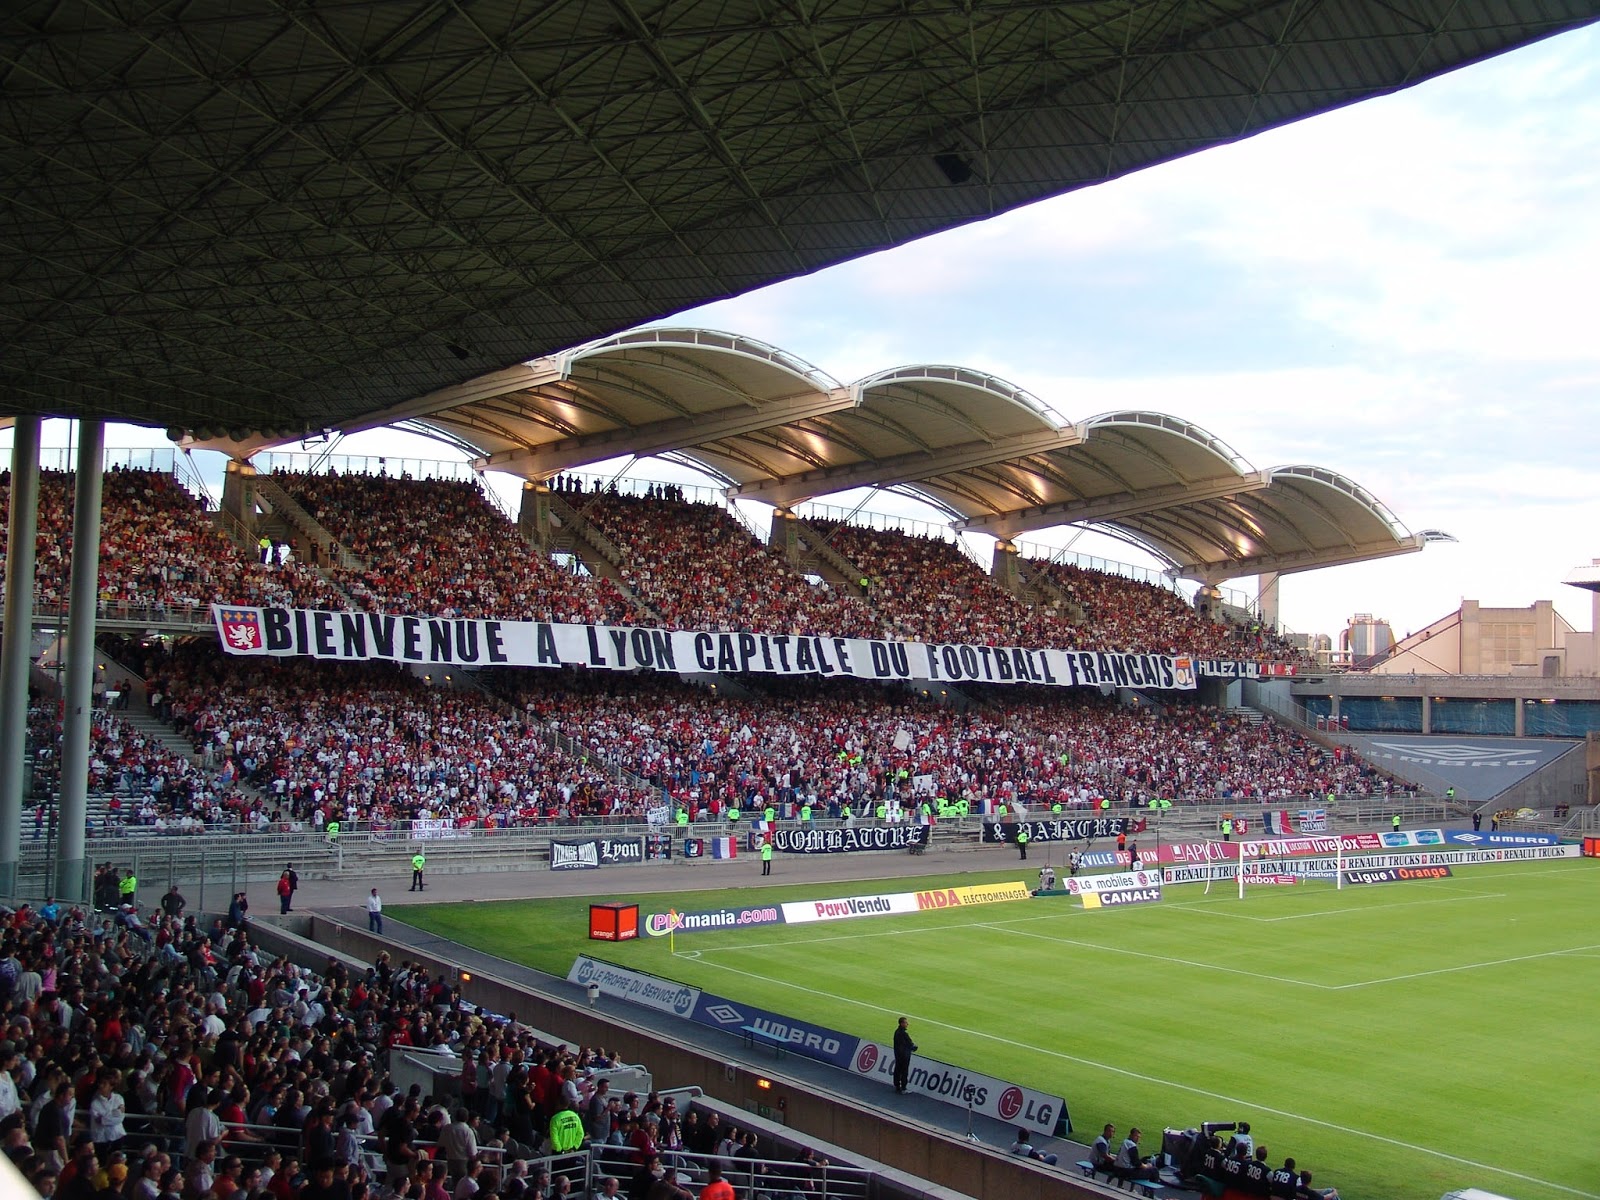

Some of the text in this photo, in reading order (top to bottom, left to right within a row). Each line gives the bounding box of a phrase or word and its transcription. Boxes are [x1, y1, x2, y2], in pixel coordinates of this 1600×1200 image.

[262, 607, 1173, 688] BIENVENUE A LYON CAPITALE DU FOOTBALL FRANCAIS
[1199, 660, 1259, 678] ALLEZ L'OL
[775, 826, 924, 852] COMBATTRE
[993, 823, 1006, 841] &
[601, 840, 640, 862] Lyon
[1185, 843, 1230, 862] APICIL
[1288, 842, 1311, 851] LOCATION
[1312, 837, 1359, 853] livebox
[1085, 853, 1114, 866] VILLE
[1116, 852, 1130, 864] DE
[1348, 854, 1420, 869] RENAULT TRUCKS
[1429, 850, 1496, 864] RENAULT TRUCKS
[1504, 847, 1565, 860] RENAULT TRUCKS
[1175, 867, 1214, 882] RENAULT
[1260, 859, 1338, 875] RENAULT TRUCKS
[1347, 866, 1447, 884] Ligue 1 Orange
[1080, 874, 1160, 890] LG mobiles LG
[916, 889, 1028, 909] MDA ELECTROMENAGER
[1101, 889, 1160, 905] CANAL+
[815, 897, 891, 918] ParuVendu
[591, 969, 605, 981] LE
[600, 971, 631, 989] PROPRE
[629, 980, 644, 993] DU
[641, 983, 676, 1004] SERVICE
[753, 1017, 841, 1055] UMBRO
[727, 1066, 734, 1081] C
[908, 1067, 988, 1106] mobiles
[1024, 1099, 1053, 1126] LG
[1204, 1153, 1215, 1169] 311
[1247, 1164, 1262, 1180] 308
[1274, 1170, 1290, 1184] 318
